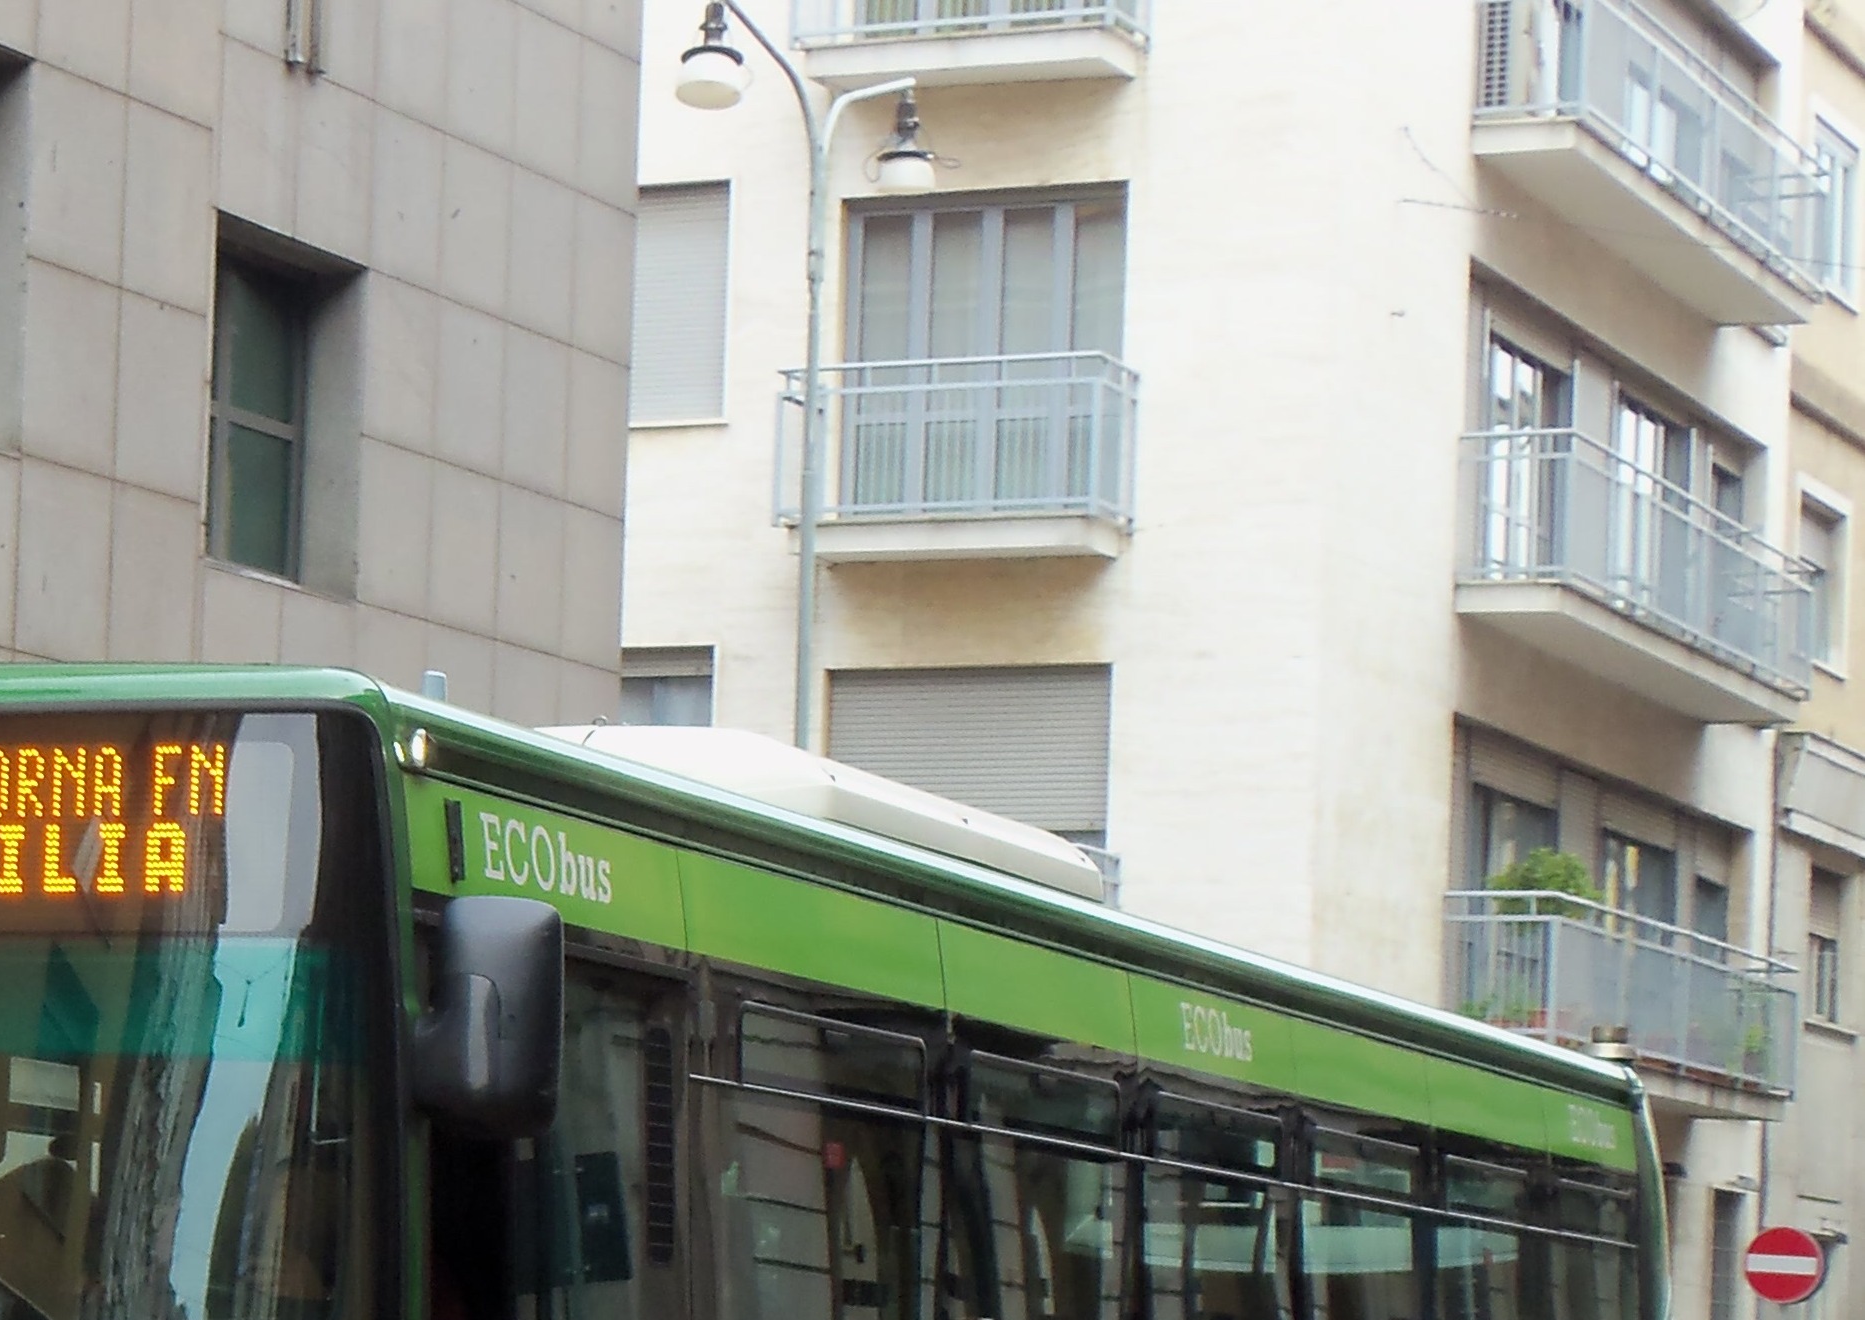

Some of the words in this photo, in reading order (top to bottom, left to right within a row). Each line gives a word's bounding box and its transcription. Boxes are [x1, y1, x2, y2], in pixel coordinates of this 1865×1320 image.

[153, 744, 225, 816] FN
[479, 811, 612, 904] ECObus
[1180, 1002, 1252, 1062] ECObus
